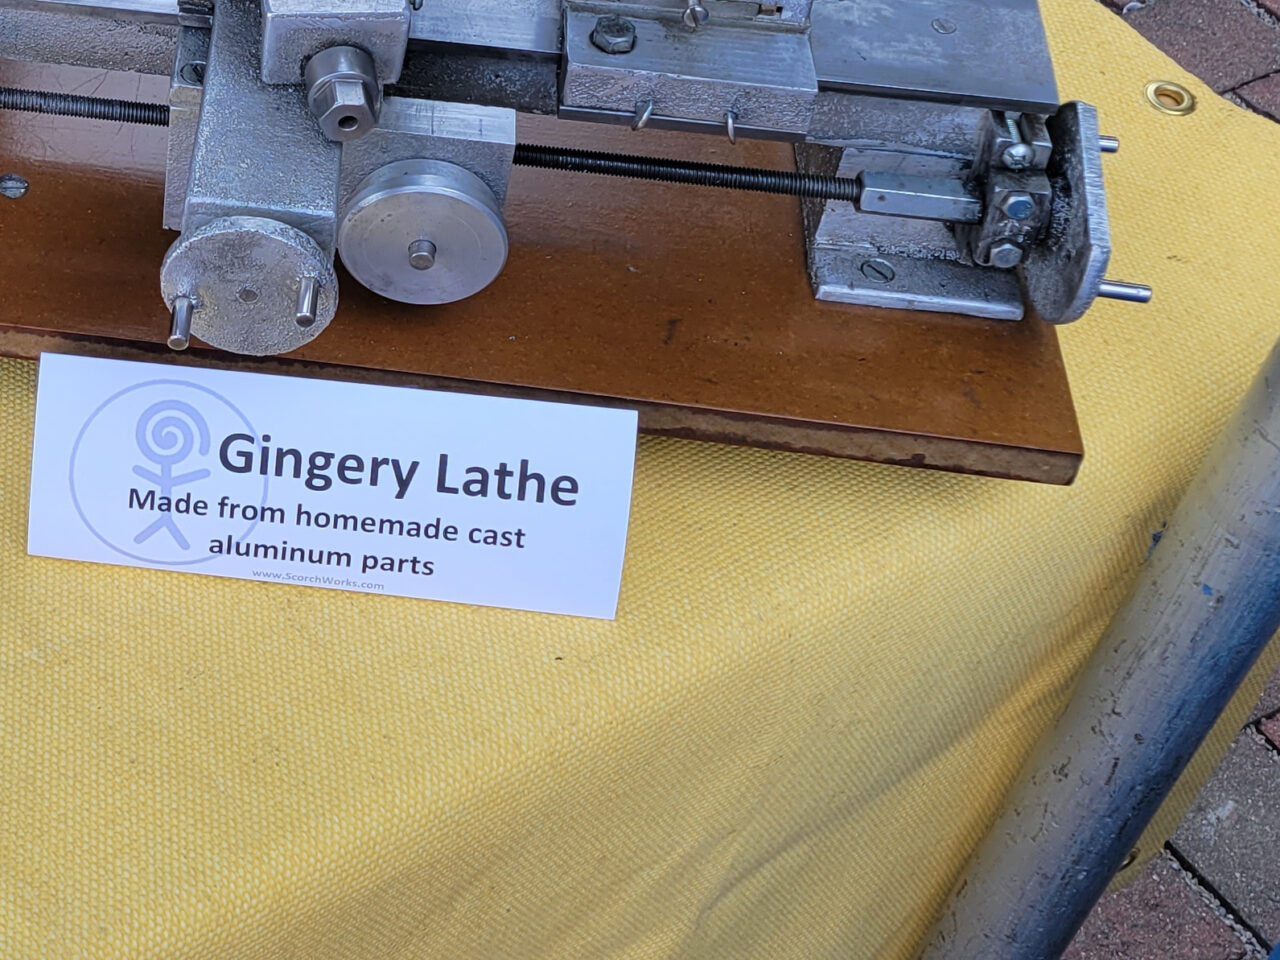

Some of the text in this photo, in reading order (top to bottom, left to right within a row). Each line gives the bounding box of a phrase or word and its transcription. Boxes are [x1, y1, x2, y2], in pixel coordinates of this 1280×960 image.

[219, 433, 580, 507] Gingery Lathe
[128, 488, 526, 549] Made from homemade cast
[208, 534, 435, 576] aluminum parts
[252, 569, 385, 590] www.ScorchWorks.com
